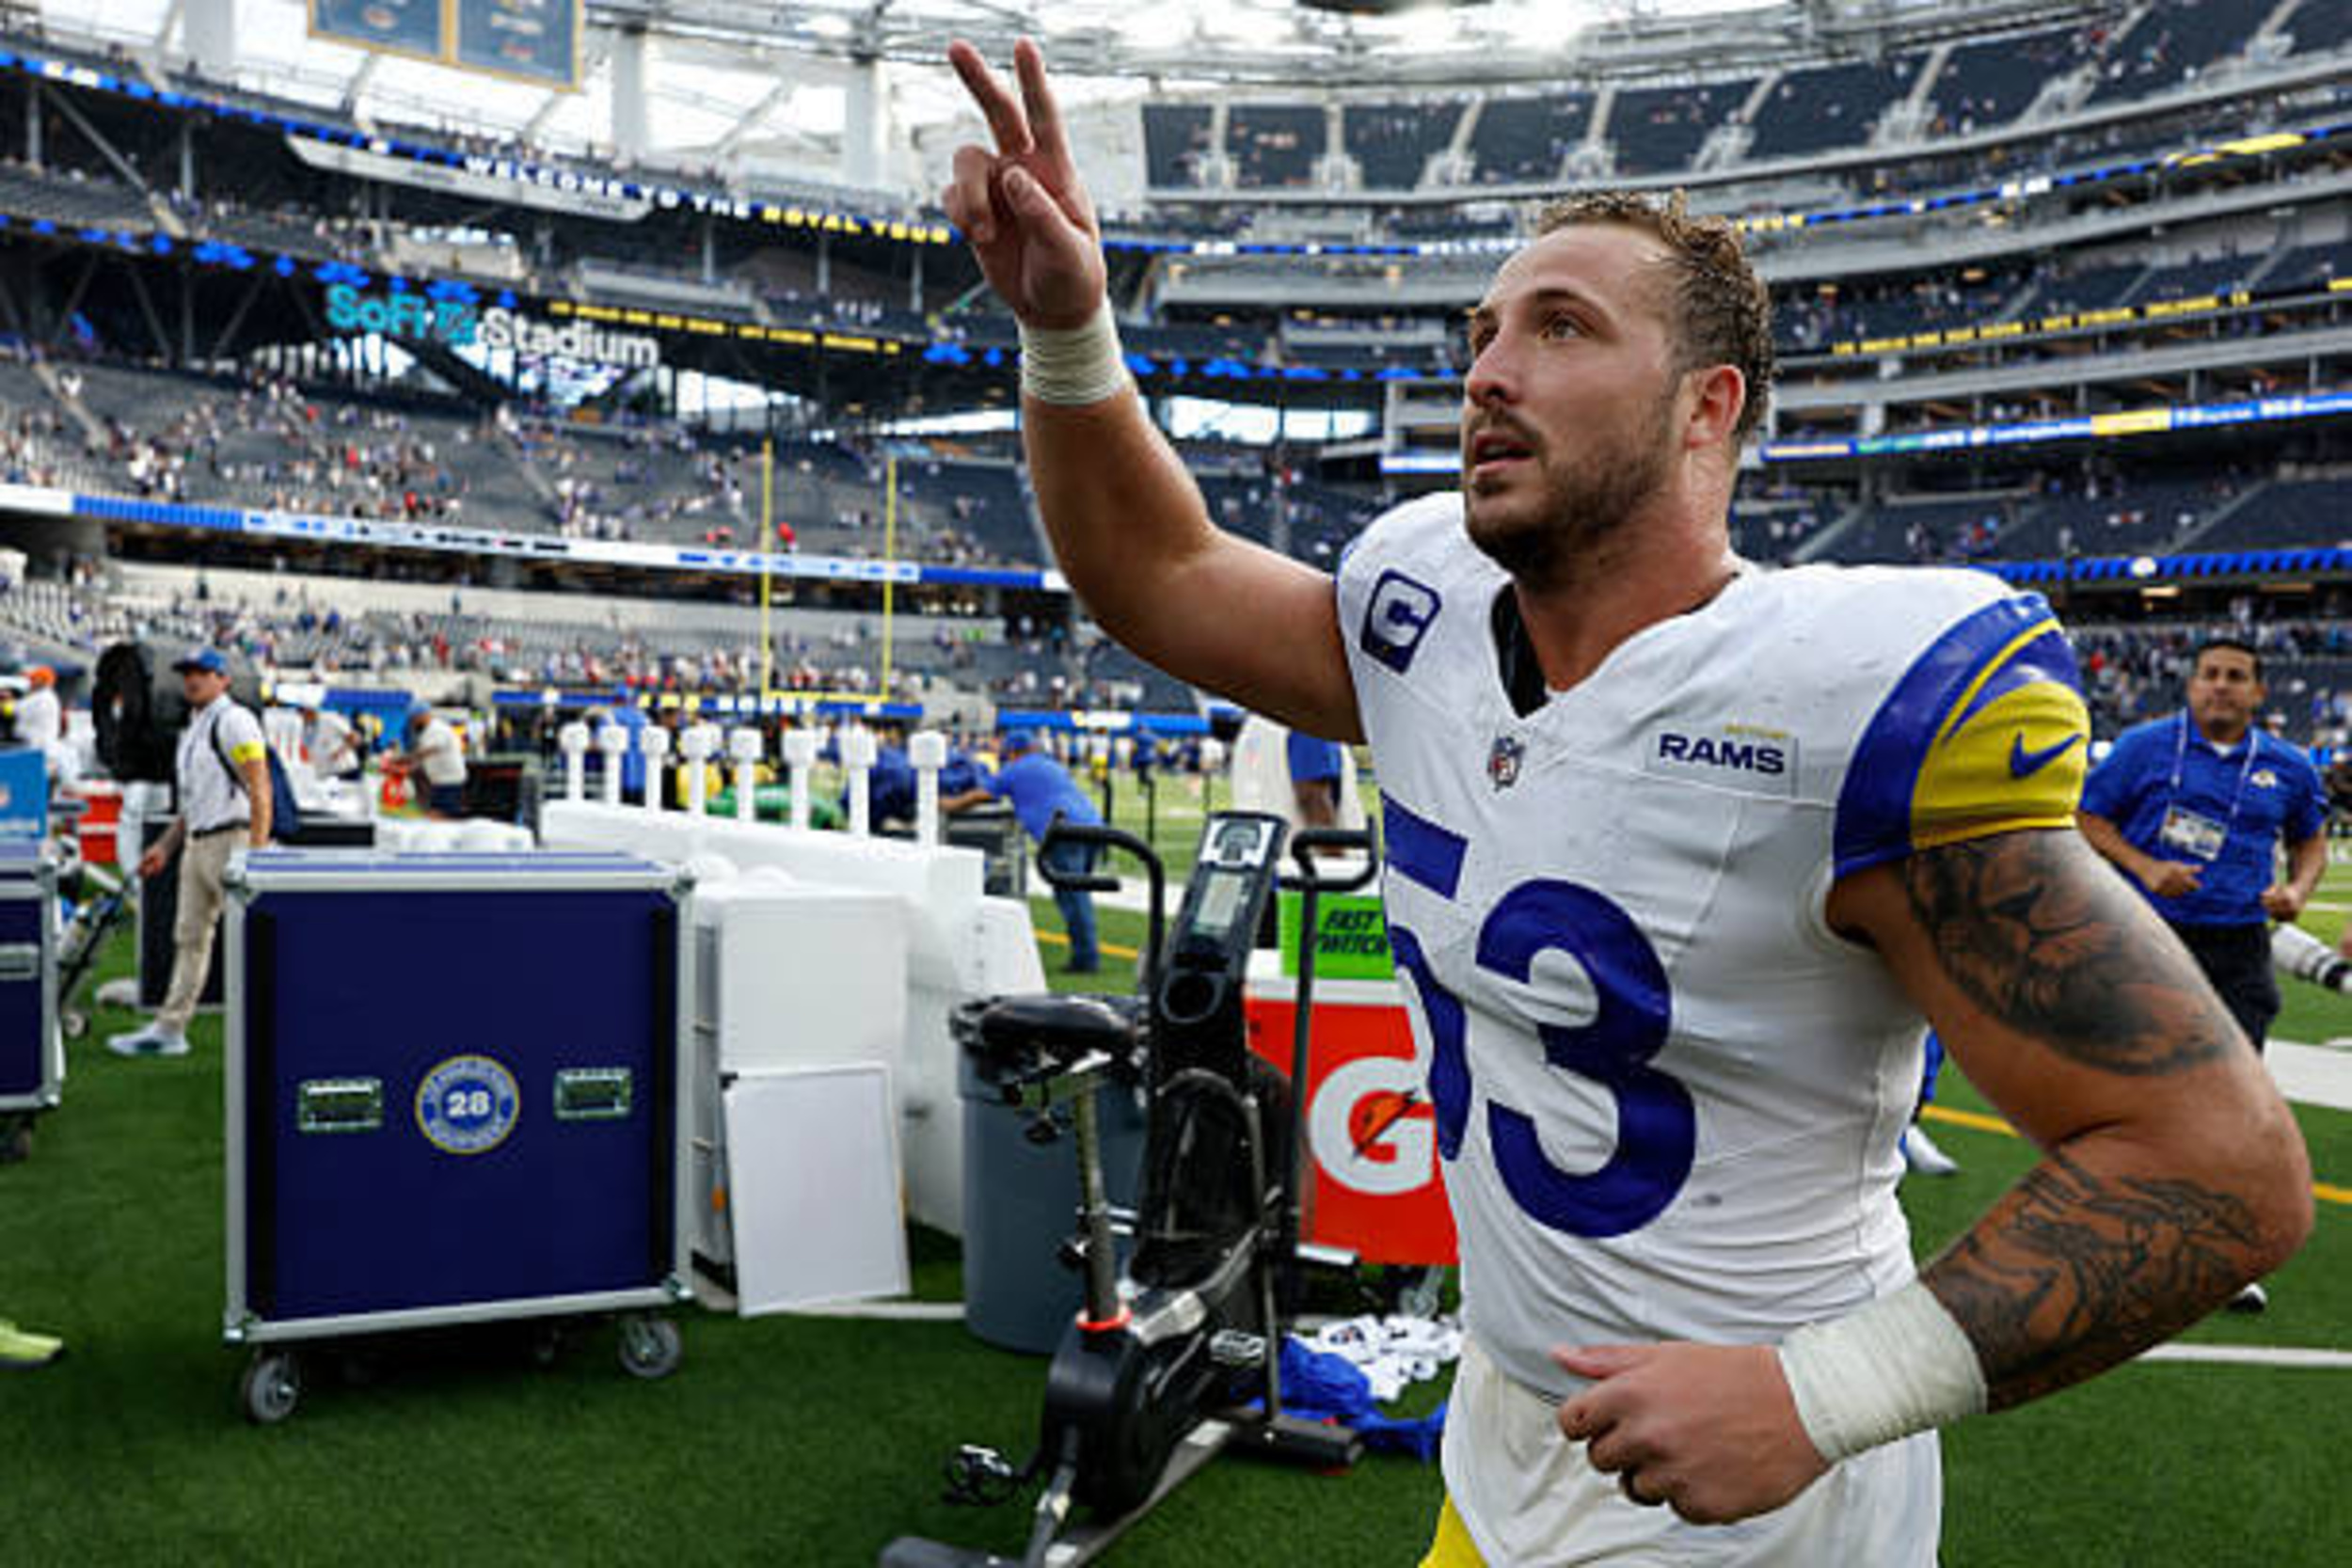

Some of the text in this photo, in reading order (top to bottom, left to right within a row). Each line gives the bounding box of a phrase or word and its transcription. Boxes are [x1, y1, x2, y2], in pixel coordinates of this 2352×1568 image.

[465, 156, 622, 200] WELCOME
[691, 194, 750, 218] THE
[327, 283, 426, 340] SoFi
[484, 307, 660, 367] Stadium
[1659, 732, 1785, 774] RAMS
[1324, 909, 1382, 931] FAST
[448, 1091, 489, 1117] 28
[1309, 1055, 1437, 1195] G
